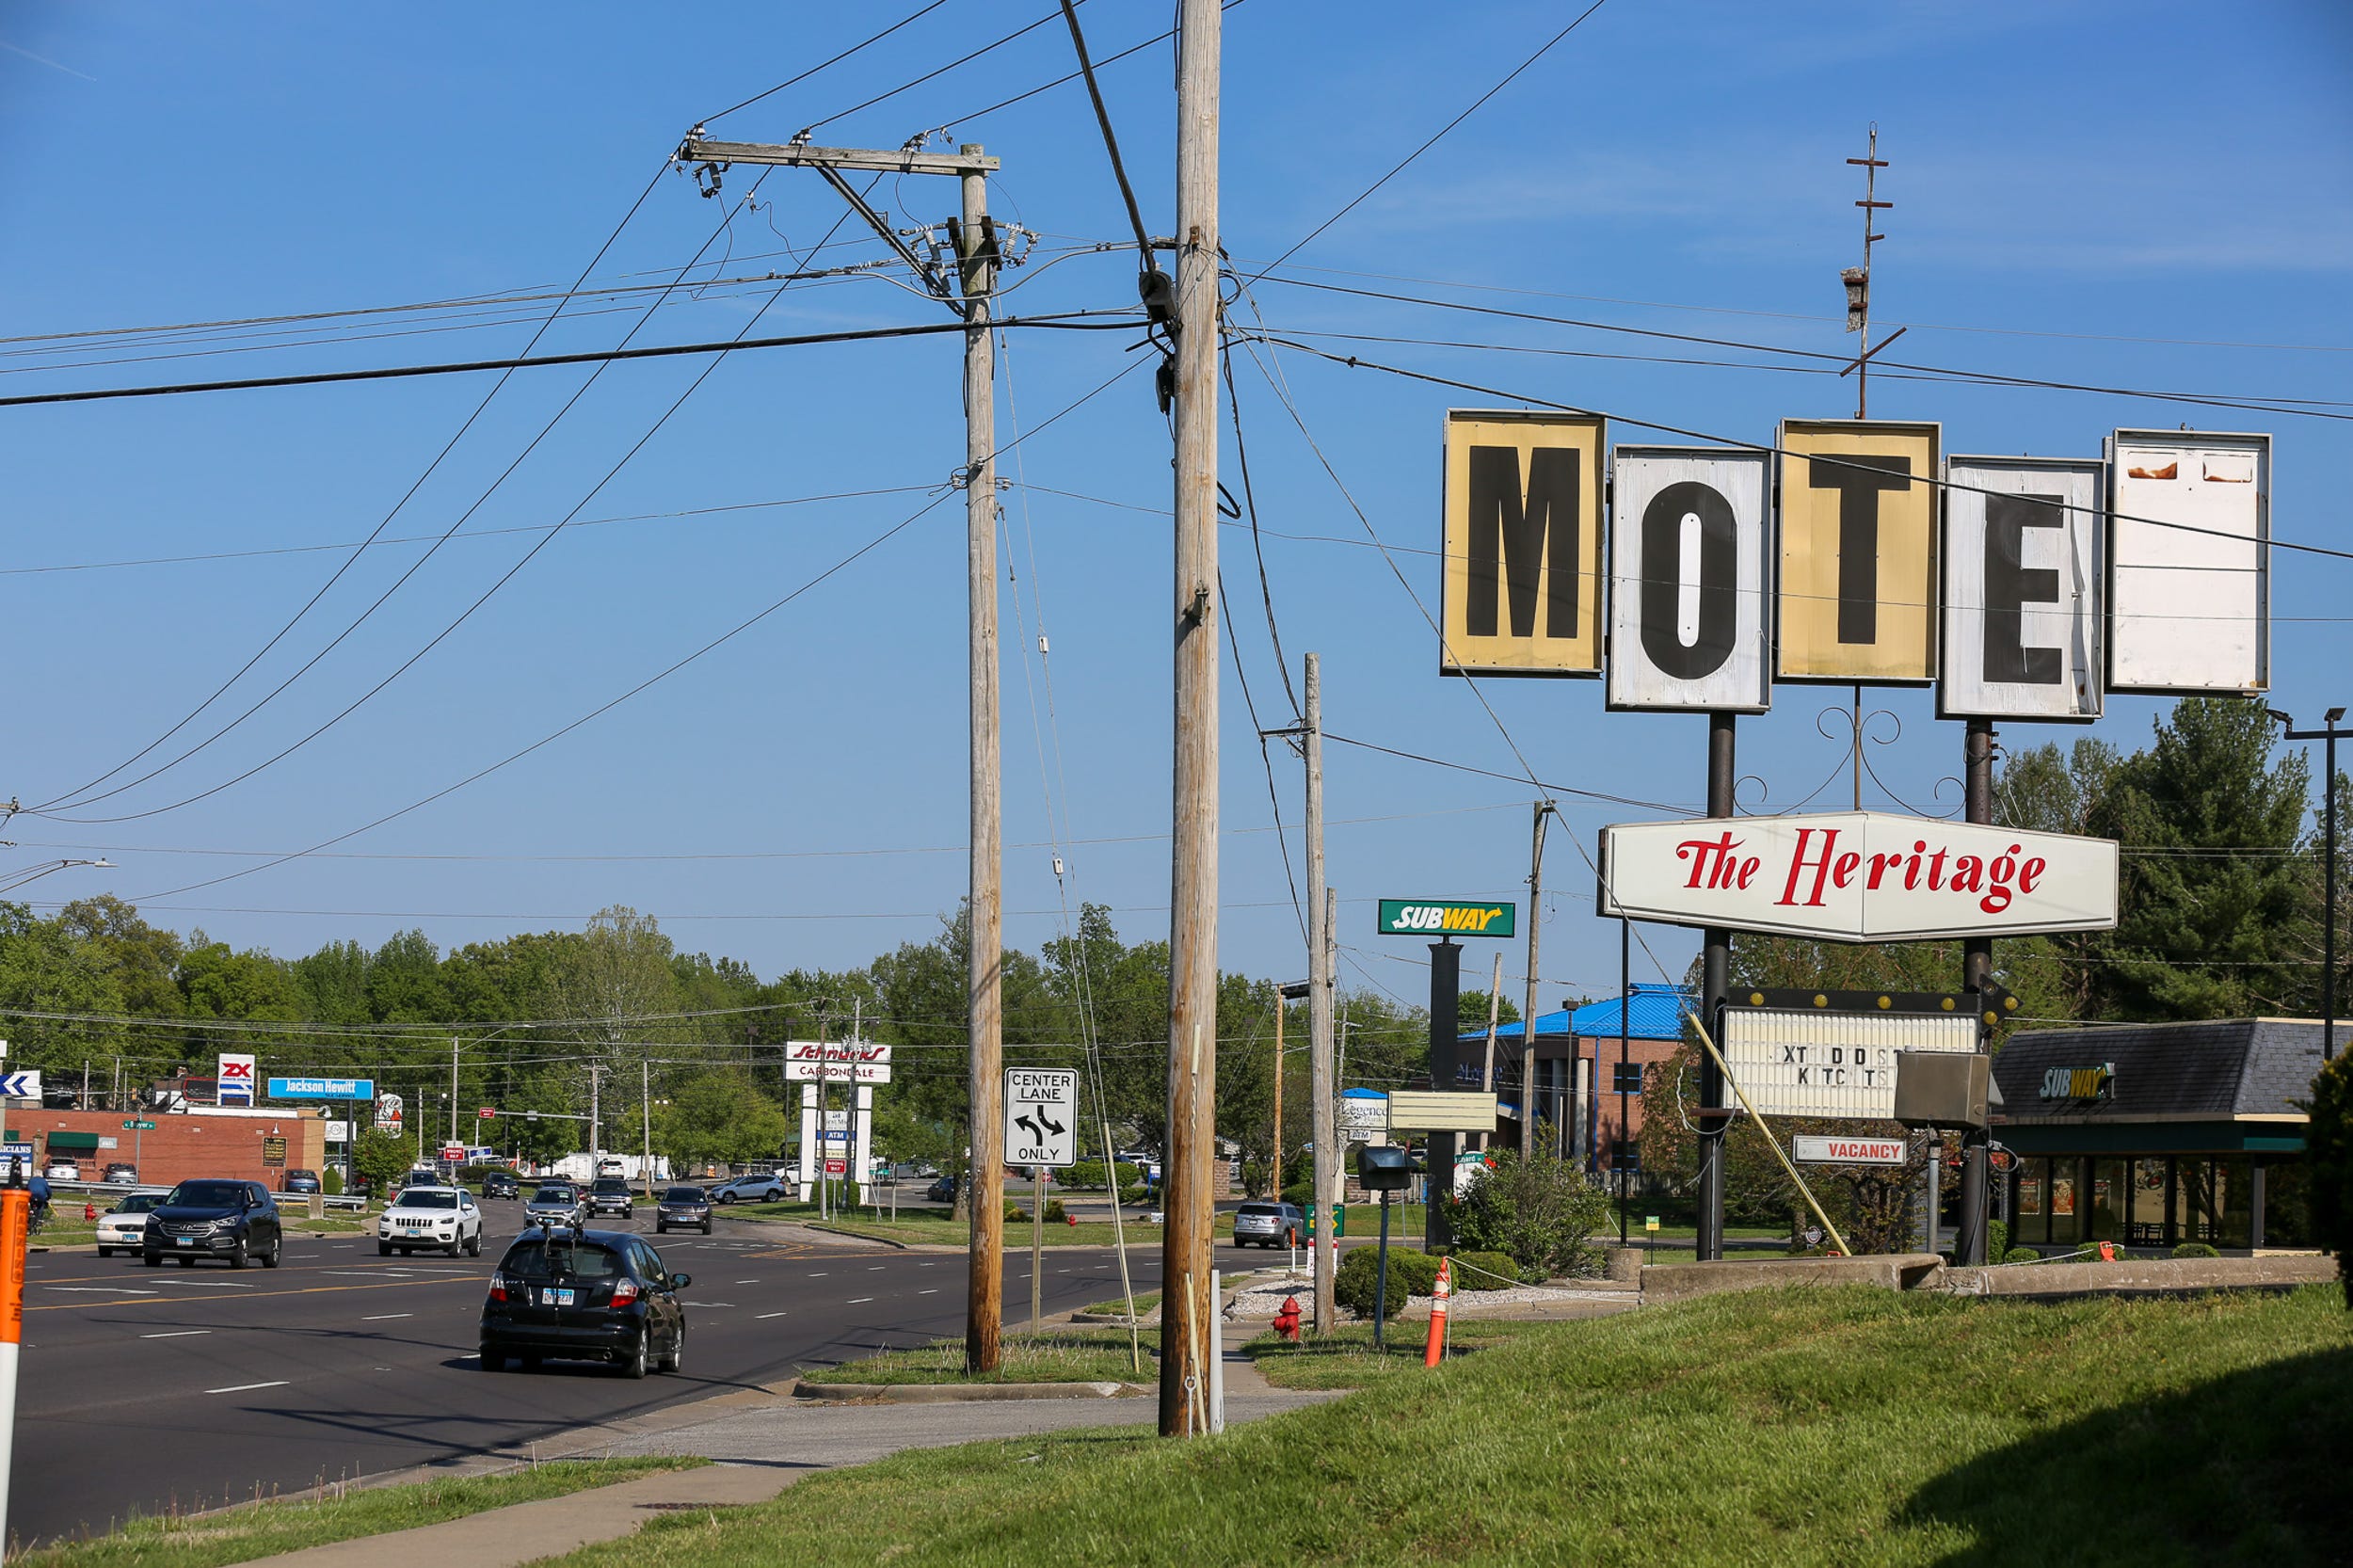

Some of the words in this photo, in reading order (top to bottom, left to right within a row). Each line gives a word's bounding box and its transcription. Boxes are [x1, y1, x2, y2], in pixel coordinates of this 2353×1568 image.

[1677, 831, 1761, 890] The
[1774, 827, 2046, 914] Heritage
[1391, 905, 1503, 931] SUBWAY
[223, 1062, 251, 1079] ZX
[285, 1080, 324, 1093] Jackson
[326, 1080, 357, 1094] Hewitt
[1012, 1074, 1071, 1087] CENTER
[2039, 1065, 2107, 1099] SUBWAY
[1020, 1087, 1061, 1099] LANE
[1018, 1147, 1060, 1160] ONLY
[1829, 1144, 1900, 1159] VACANCY
